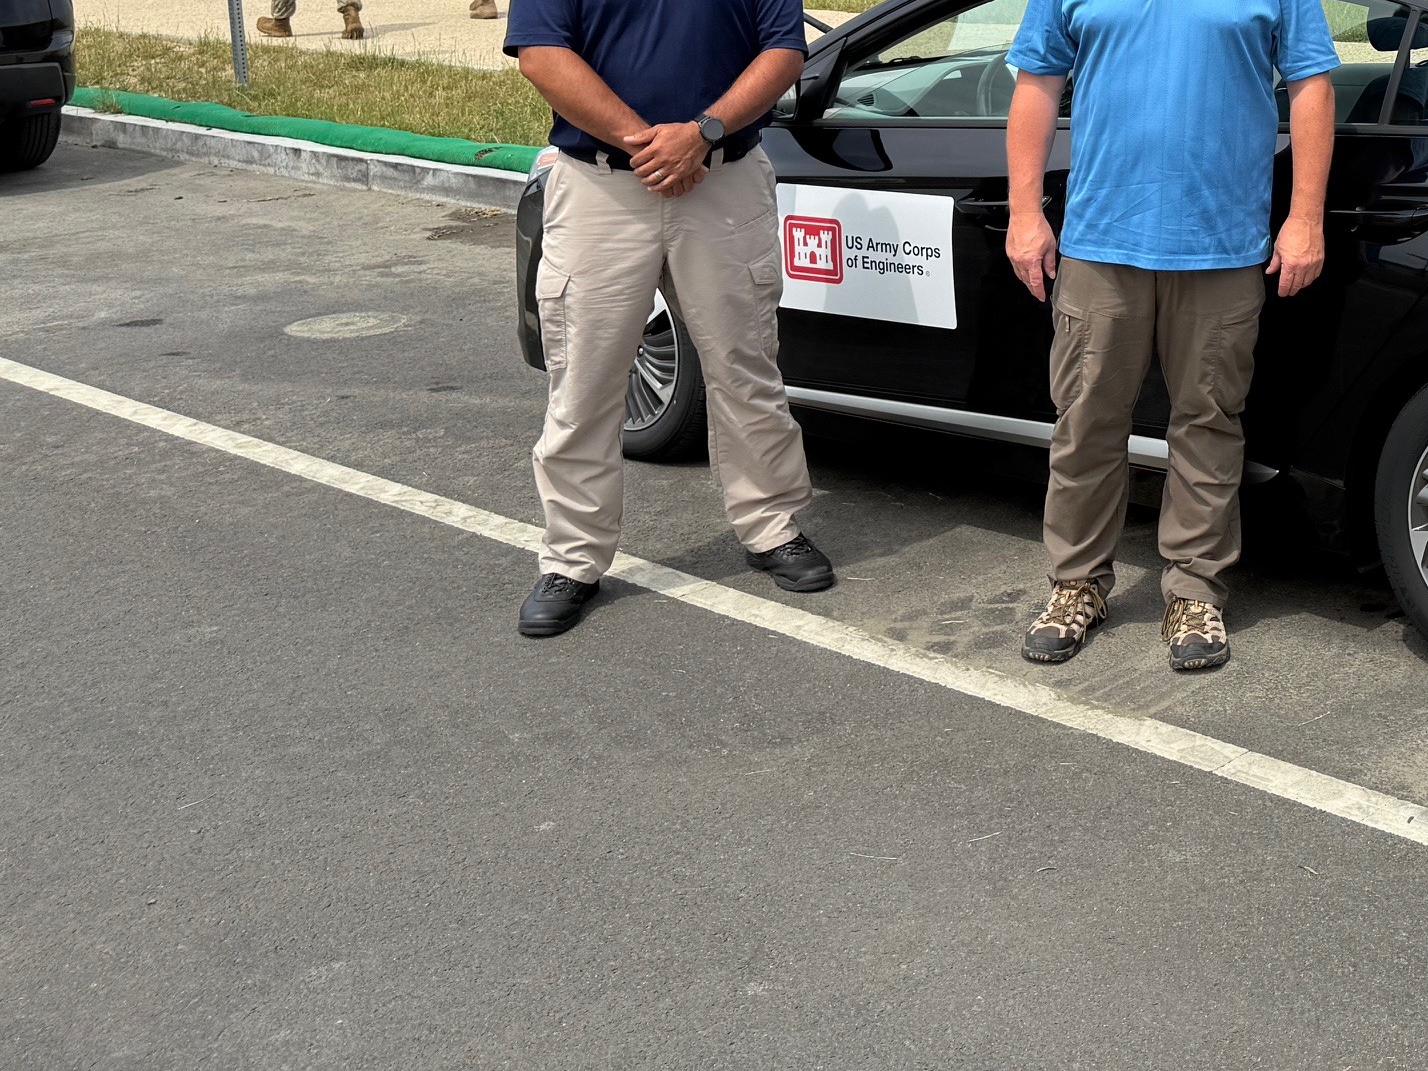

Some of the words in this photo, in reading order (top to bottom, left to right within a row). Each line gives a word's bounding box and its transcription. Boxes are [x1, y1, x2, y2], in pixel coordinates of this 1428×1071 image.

[845, 235, 863, 251] US
[866, 237, 899, 257] Army
[902, 241, 941, 260] Corps
[846, 255, 859, 269] of
[862, 256, 924, 275] Engineers
